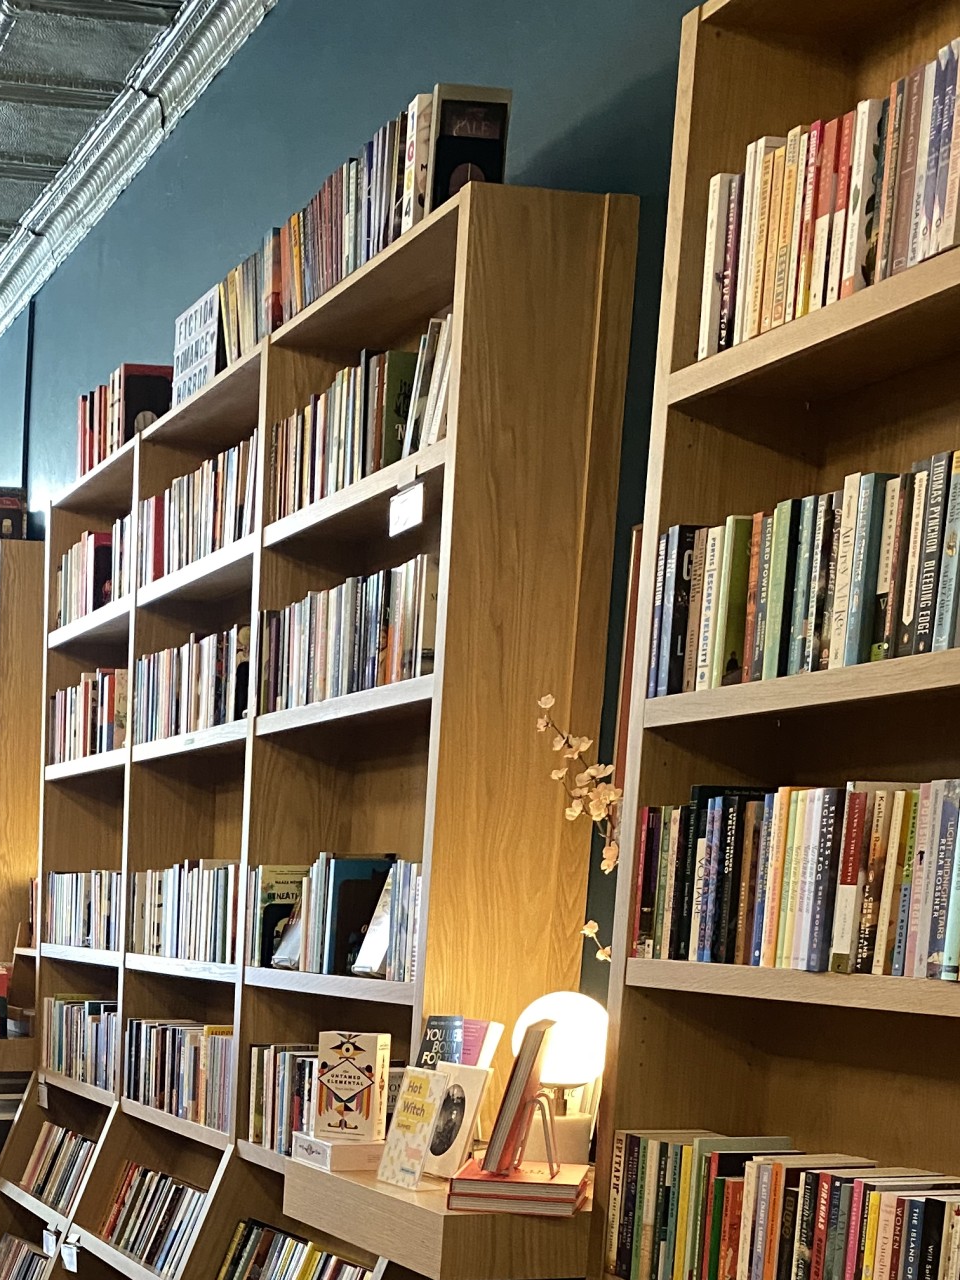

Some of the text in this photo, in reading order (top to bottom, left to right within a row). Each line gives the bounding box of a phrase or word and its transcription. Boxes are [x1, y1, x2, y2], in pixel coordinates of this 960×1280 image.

[808, 130, 817, 162] CHUCK
[179, 294, 214, 345] FICTION
[718, 268, 731, 344] TRUE STORY
[176, 365, 208, 405] HORROR
[759, 518, 773, 603] RICHARD POWERS
[917, 459, 944, 635] THOMAS PYNCHON BLEEDING EDGE
[654, 539, 665, 606] IMPERSONATION
[705, 572, 713, 611] ESCAPE
[827, 561, 835, 594] HORSES
[700, 616, 709, 662] VELOCITY
[821, 794, 829, 832] NIGHT
[825, 806, 835, 854] SISTERS
[694, 857, 703, 914] VOLTAIRE
[932, 870, 942, 917] ROSSNER
[936, 821, 954, 939] LIGHT MIDNIGHT STARS
[426, 1028, 445, 1041] YOU
[402, 1100, 425, 1117] Witch
[408, 1080, 422, 1095] Hot
[612, 1138, 622, 1190] EPITAPH
[817, 1182, 829, 1230] PIRANHAS
[893, 1207, 903, 1248] WOMEN
[908, 1228, 916, 1262] ISLAND
[906, 1266, 912, 1278] OF
